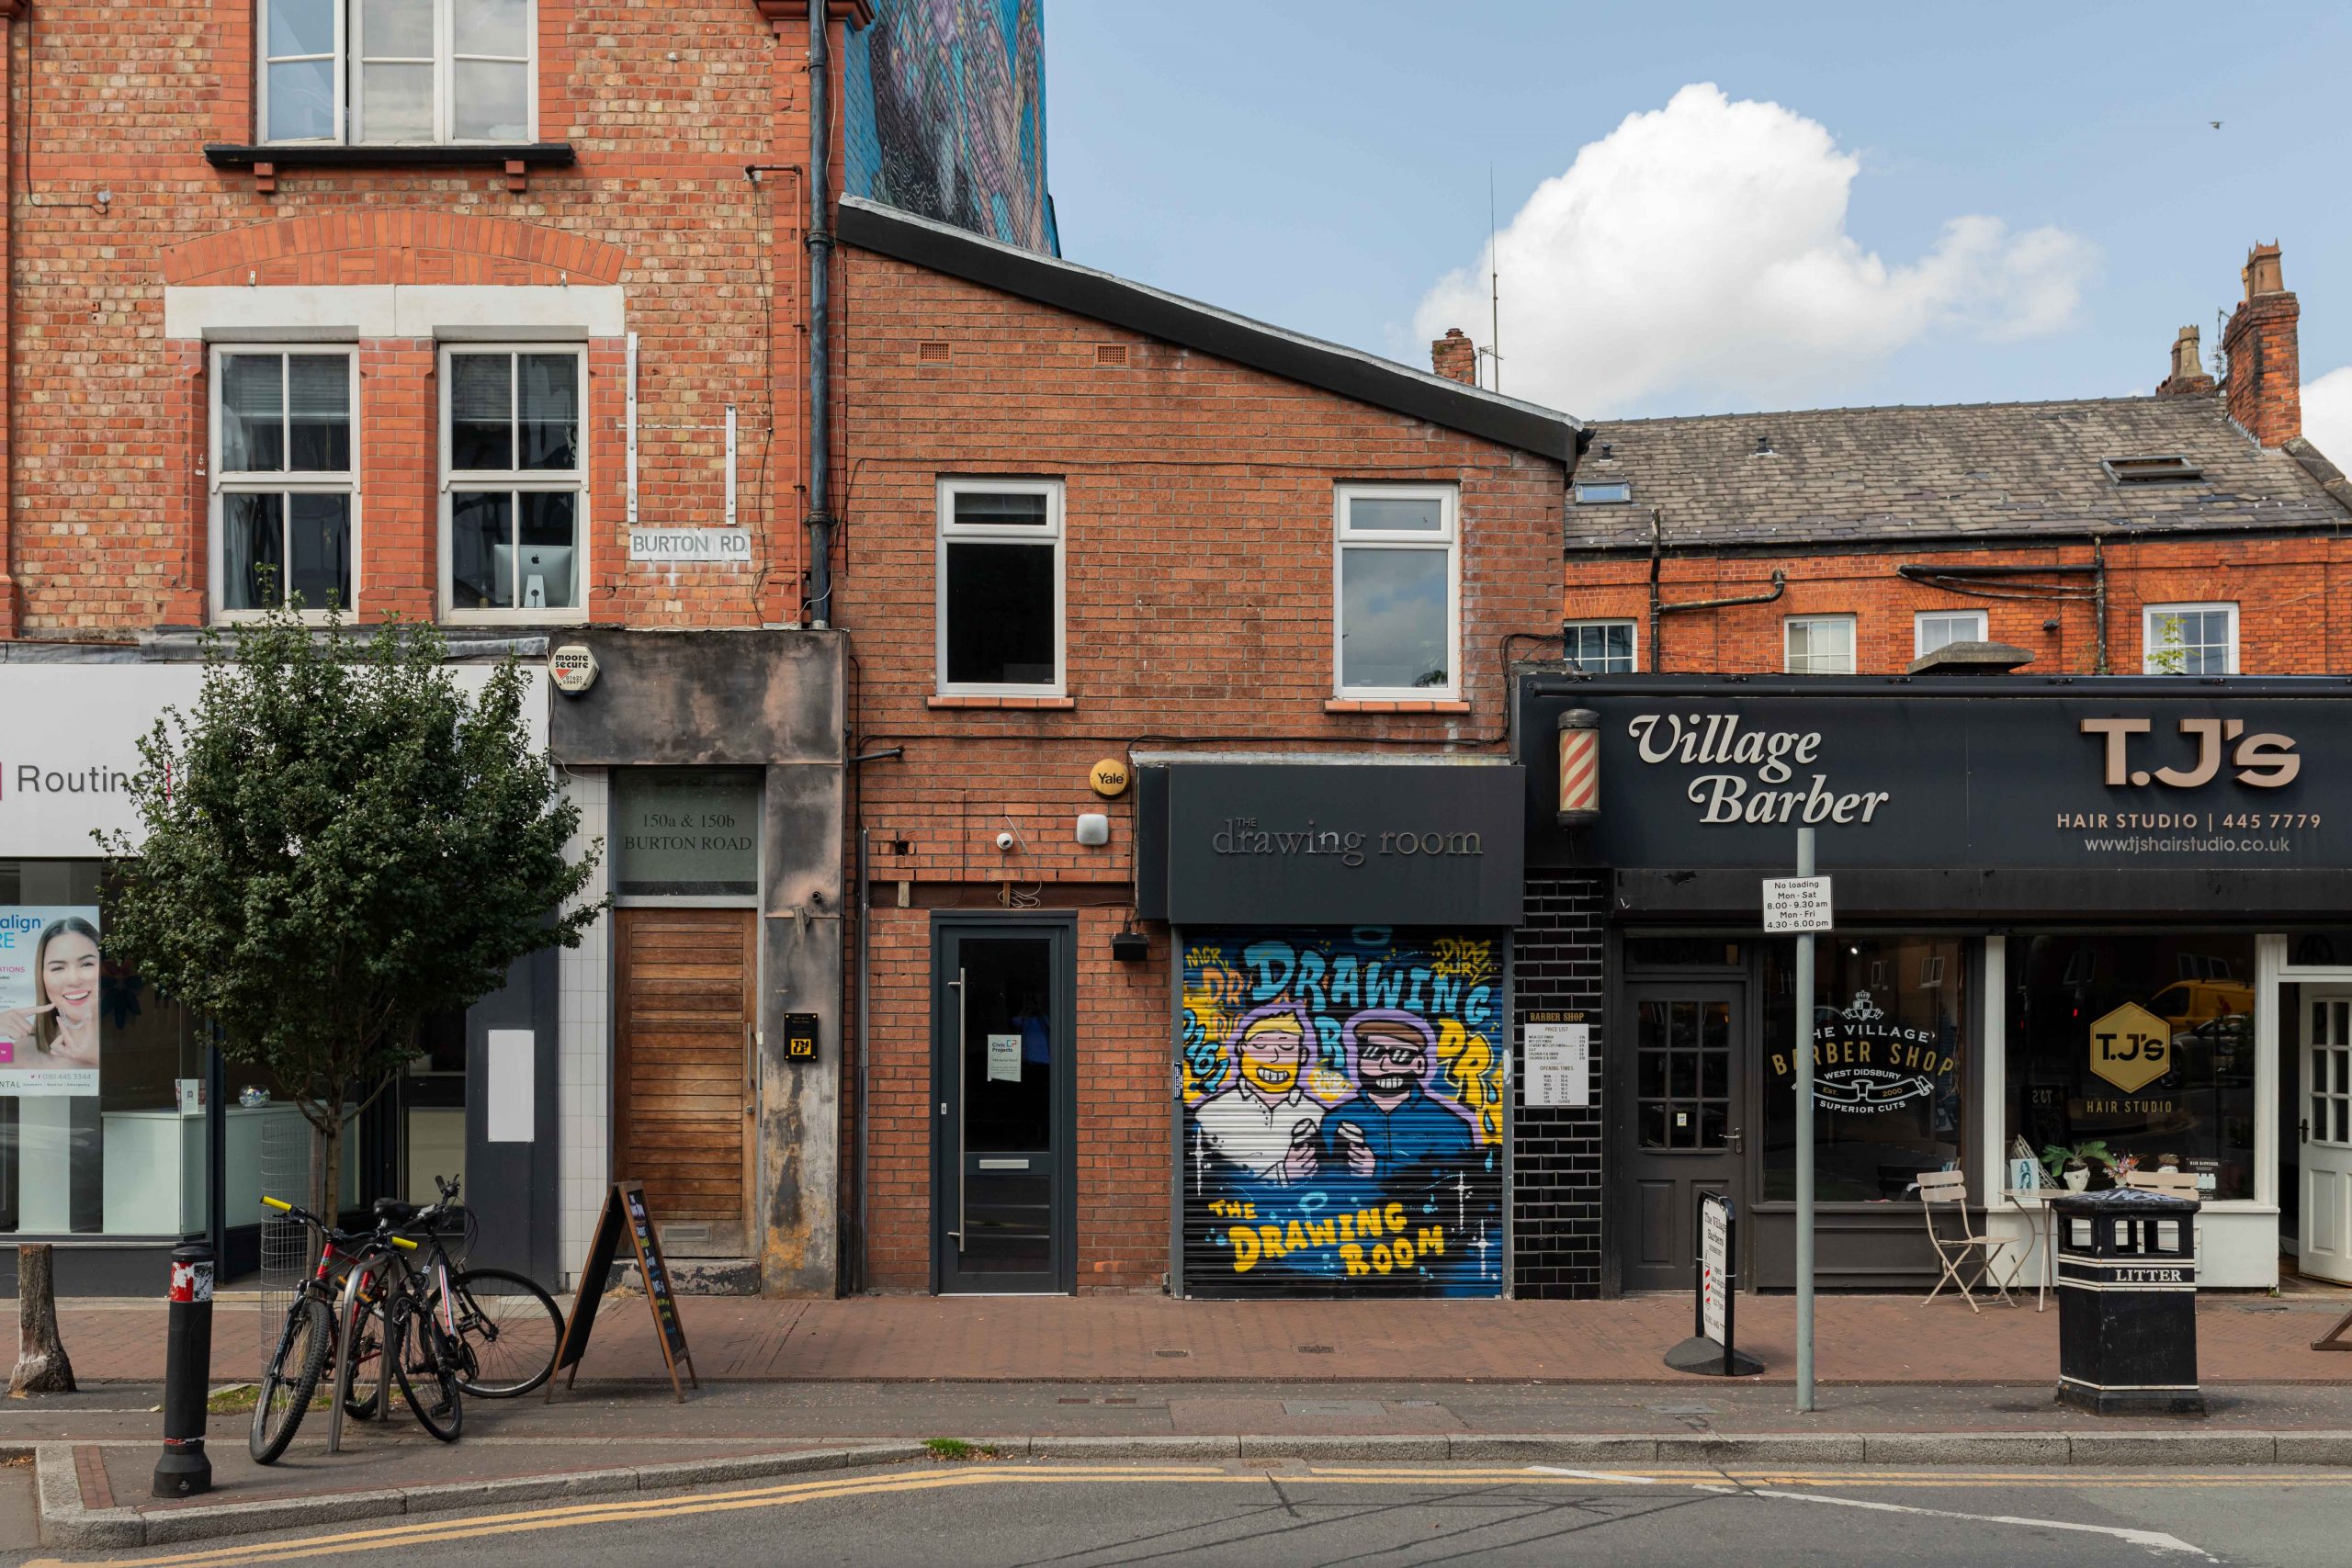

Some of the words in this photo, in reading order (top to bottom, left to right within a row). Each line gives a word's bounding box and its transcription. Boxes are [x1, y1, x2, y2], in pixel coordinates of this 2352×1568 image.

[633, 536, 708, 552] BURTON
[720, 536, 747, 552] RD.
[1628, 714, 1822, 784] Village
[2081, 718, 2301, 787] T.J's
[1098, 773, 1124, 784] Yale
[1688, 774, 1889, 823] Barber
[643, 814, 675, 828] 150a
[681, 814, 694, 828] &
[702, 814, 735, 828] 150b
[1236, 818, 1257, 828] THE
[2057, 813, 2109, 829] HAIR
[2116, 813, 2198, 829] STUDIO
[2222, 814, 2261, 829] 445
[2269, 814, 2321, 829] 7779
[625, 836, 695, 850] BURTON
[701, 837, 752, 851] ROAD
[1213, 818, 1366, 866] drawing
[1379, 830, 1485, 855] room
[2085, 836, 2290, 854] www.tjshairstudio.co.uk
[1767, 920, 1788, 929] 4.30
[1793, 919, 1814, 928] 6.00
[1243, 941, 1491, 1024] DRAWING
[1530, 1012, 1561, 1021] BARBER
[1563, 1012, 1585, 1021] SHOP
[1813, 1026, 1836, 1039] HE
[1844, 1024, 1929, 1043] VILLAGE
[2096, 1033, 2165, 1062] T.J's
[1889, 1043, 1954, 1077] SHOP
[1824, 1069, 1851, 1080] WEST
[1853, 1068, 1902, 1080] DIDSBURY
[1883, 1088, 1903, 1098] 2000
[1819, 1100, 1874, 1113] SUPERIOR
[1878, 1100, 1906, 1112] CUTS
[2086, 1100, 2118, 1113] HAIR
[2124, 1100, 2172, 1113] STUDIO
[1208, 1199, 1257, 1219] THE
[1228, 1202, 1408, 1272] DRAWING
[1707, 1228, 1724, 1247] Barbers
[1339, 1225, 1444, 1276] ROOM
[2115, 1269, 2182, 1281] LITTER
